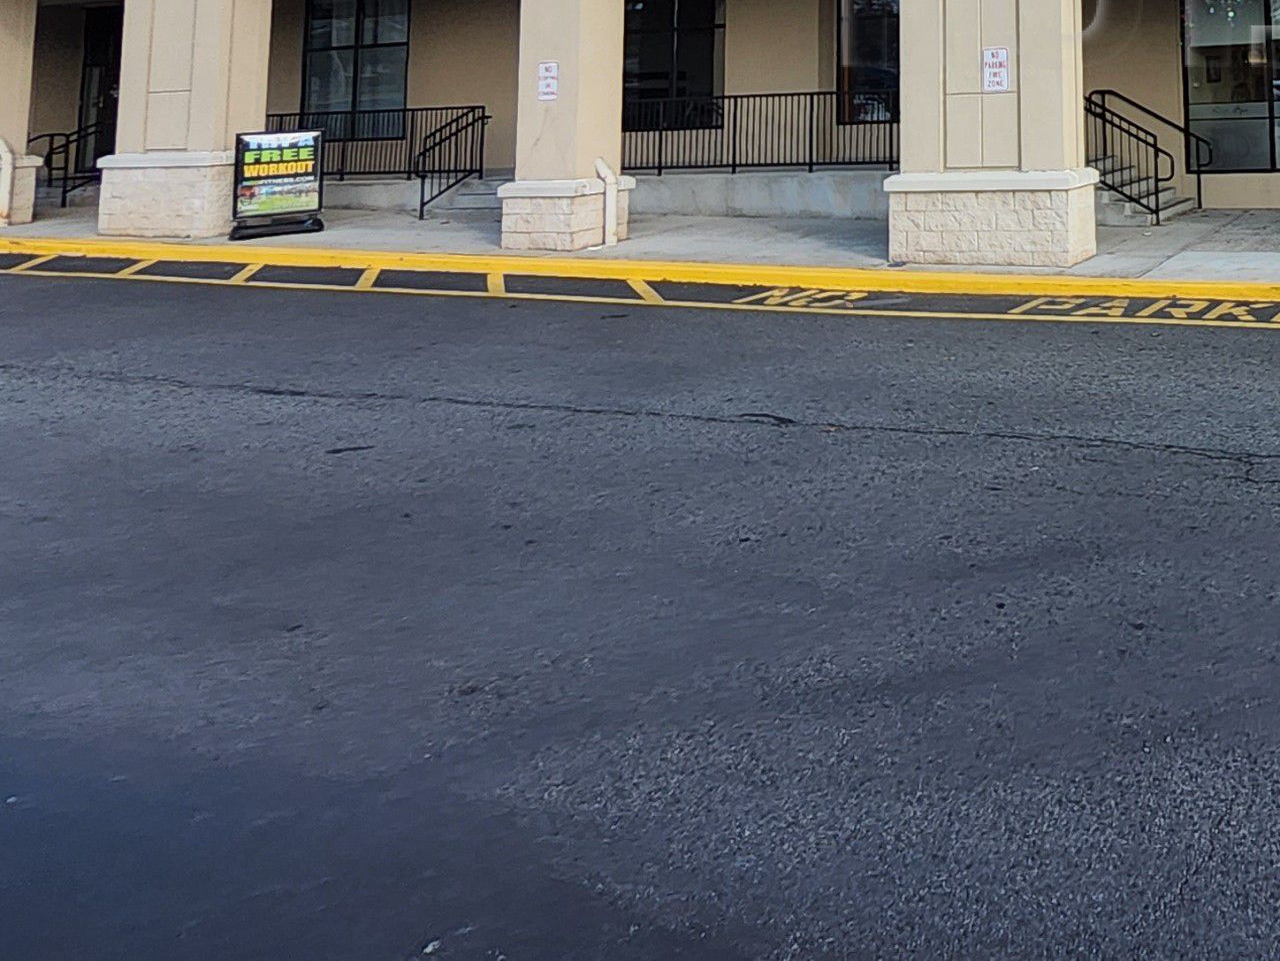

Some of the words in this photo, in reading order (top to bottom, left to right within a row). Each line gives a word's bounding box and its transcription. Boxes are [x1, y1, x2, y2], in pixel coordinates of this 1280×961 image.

[991, 51, 1000, 59] NO
[985, 61, 1006, 69] PARKING
[987, 80, 1004, 88] ZONE
[244, 148, 315, 164] FREE
[243, 160, 316, 178] WORKOUT
